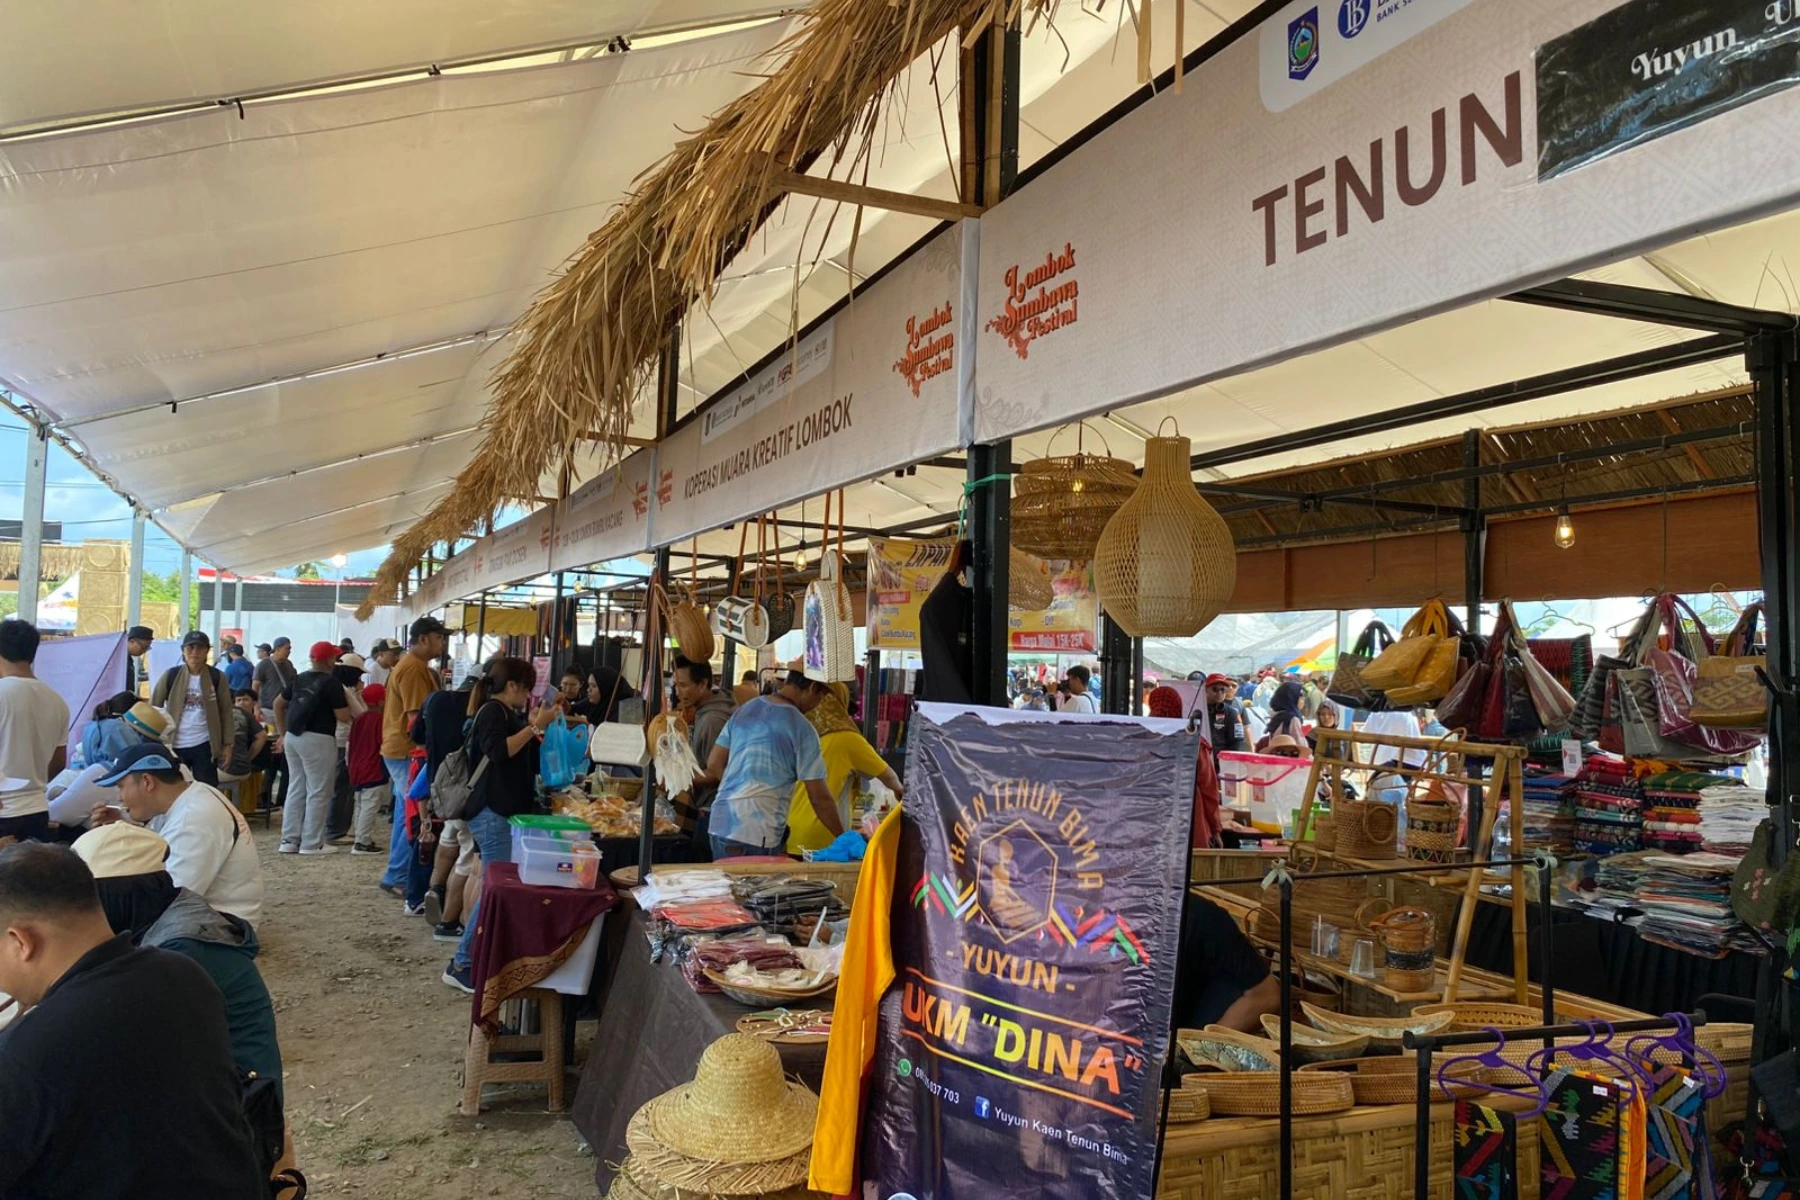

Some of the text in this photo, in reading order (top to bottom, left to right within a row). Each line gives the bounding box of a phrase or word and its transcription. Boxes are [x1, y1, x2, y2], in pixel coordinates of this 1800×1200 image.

[1376, 2, 1400, 22] BANK
[1631, 0, 1800, 80] Yuyun U
[1252, 70, 1522, 266] TENUN
[1004, 242, 1076, 303] Lombok
[906, 300, 953, 348] Lombok
[684, 464, 719, 499] KOPERASI
[719, 448, 750, 484] MUARA
[752, 424, 794, 471] KREATIF
[796, 393, 853, 450] LOMBOK
[950, 778, 1103, 890] KAEN TENUN BIMA
[963, 941, 1059, 994] YUYUN
[901, 982, 971, 1045] UKM
[944, 1088, 960, 1104] 703
[994, 1107, 1029, 1128] Yuyun
[1033, 1120, 1062, 1139] Kaen
[1065, 1130, 1100, 1153] Tenun
[1103, 1143, 1128, 1166] Bima
